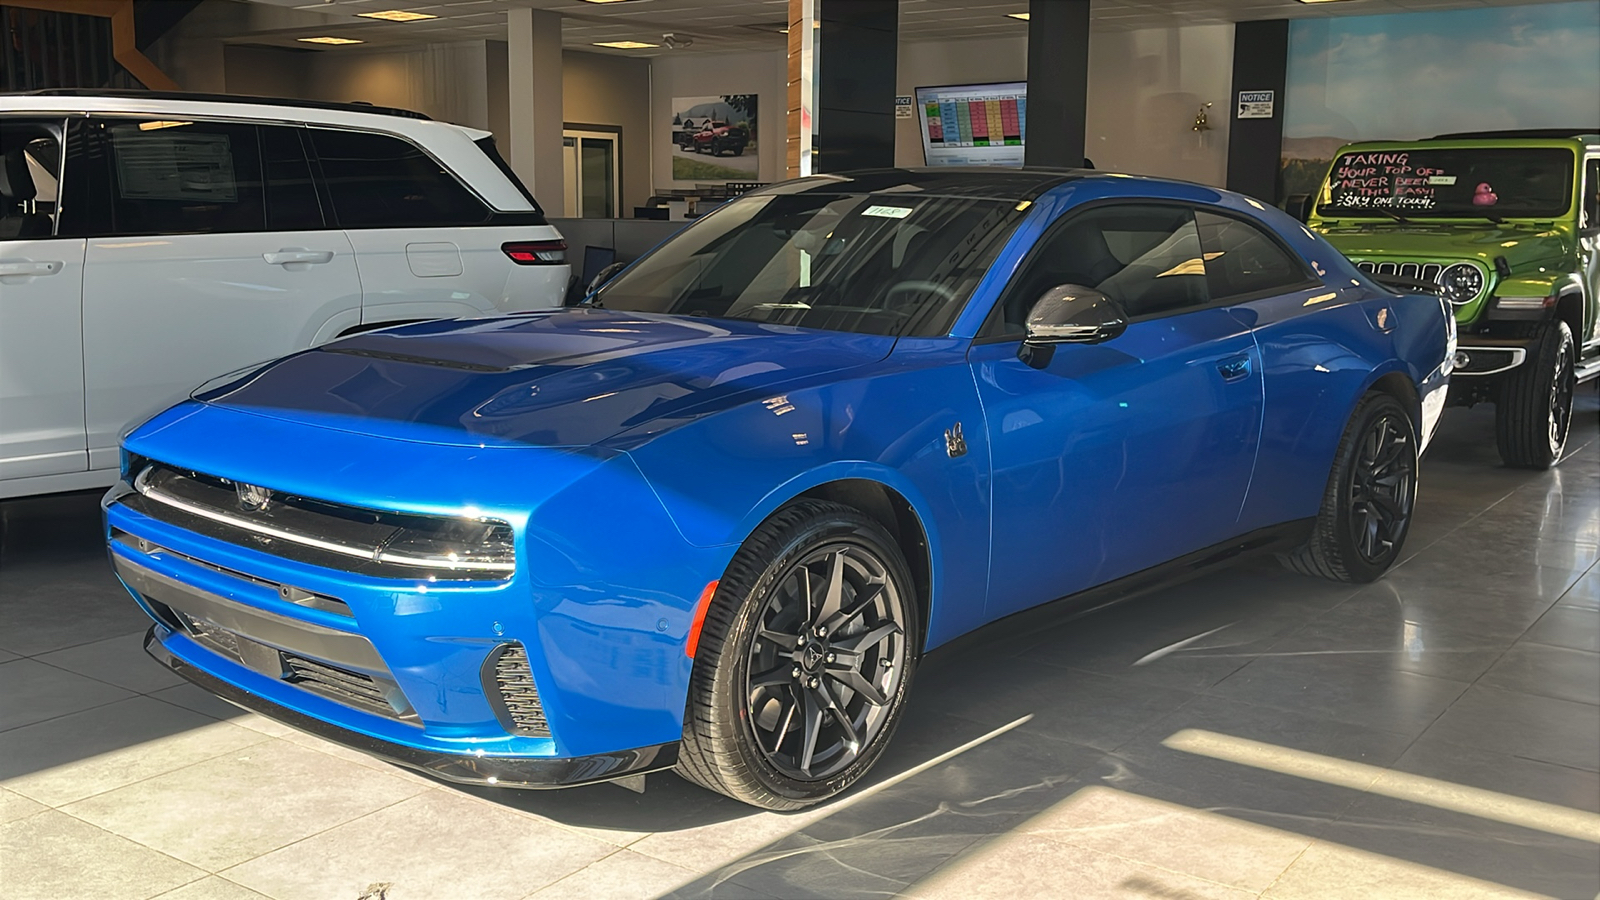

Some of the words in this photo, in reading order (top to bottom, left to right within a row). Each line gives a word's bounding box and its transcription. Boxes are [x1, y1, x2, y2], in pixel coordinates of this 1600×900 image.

[896, 97, 910, 105] TICE
[1241, 93, 1271, 102] NOTICE
[1343, 153, 1409, 165] TAKING
[1338, 166, 1376, 178] YOUR
[1384, 165, 1412, 175] TOP
[1341, 177, 1389, 189] NEVER
[1395, 177, 1431, 186] BEEN
[1359, 187, 1390, 196] THIS
[1343, 195, 1370, 206] SKY
